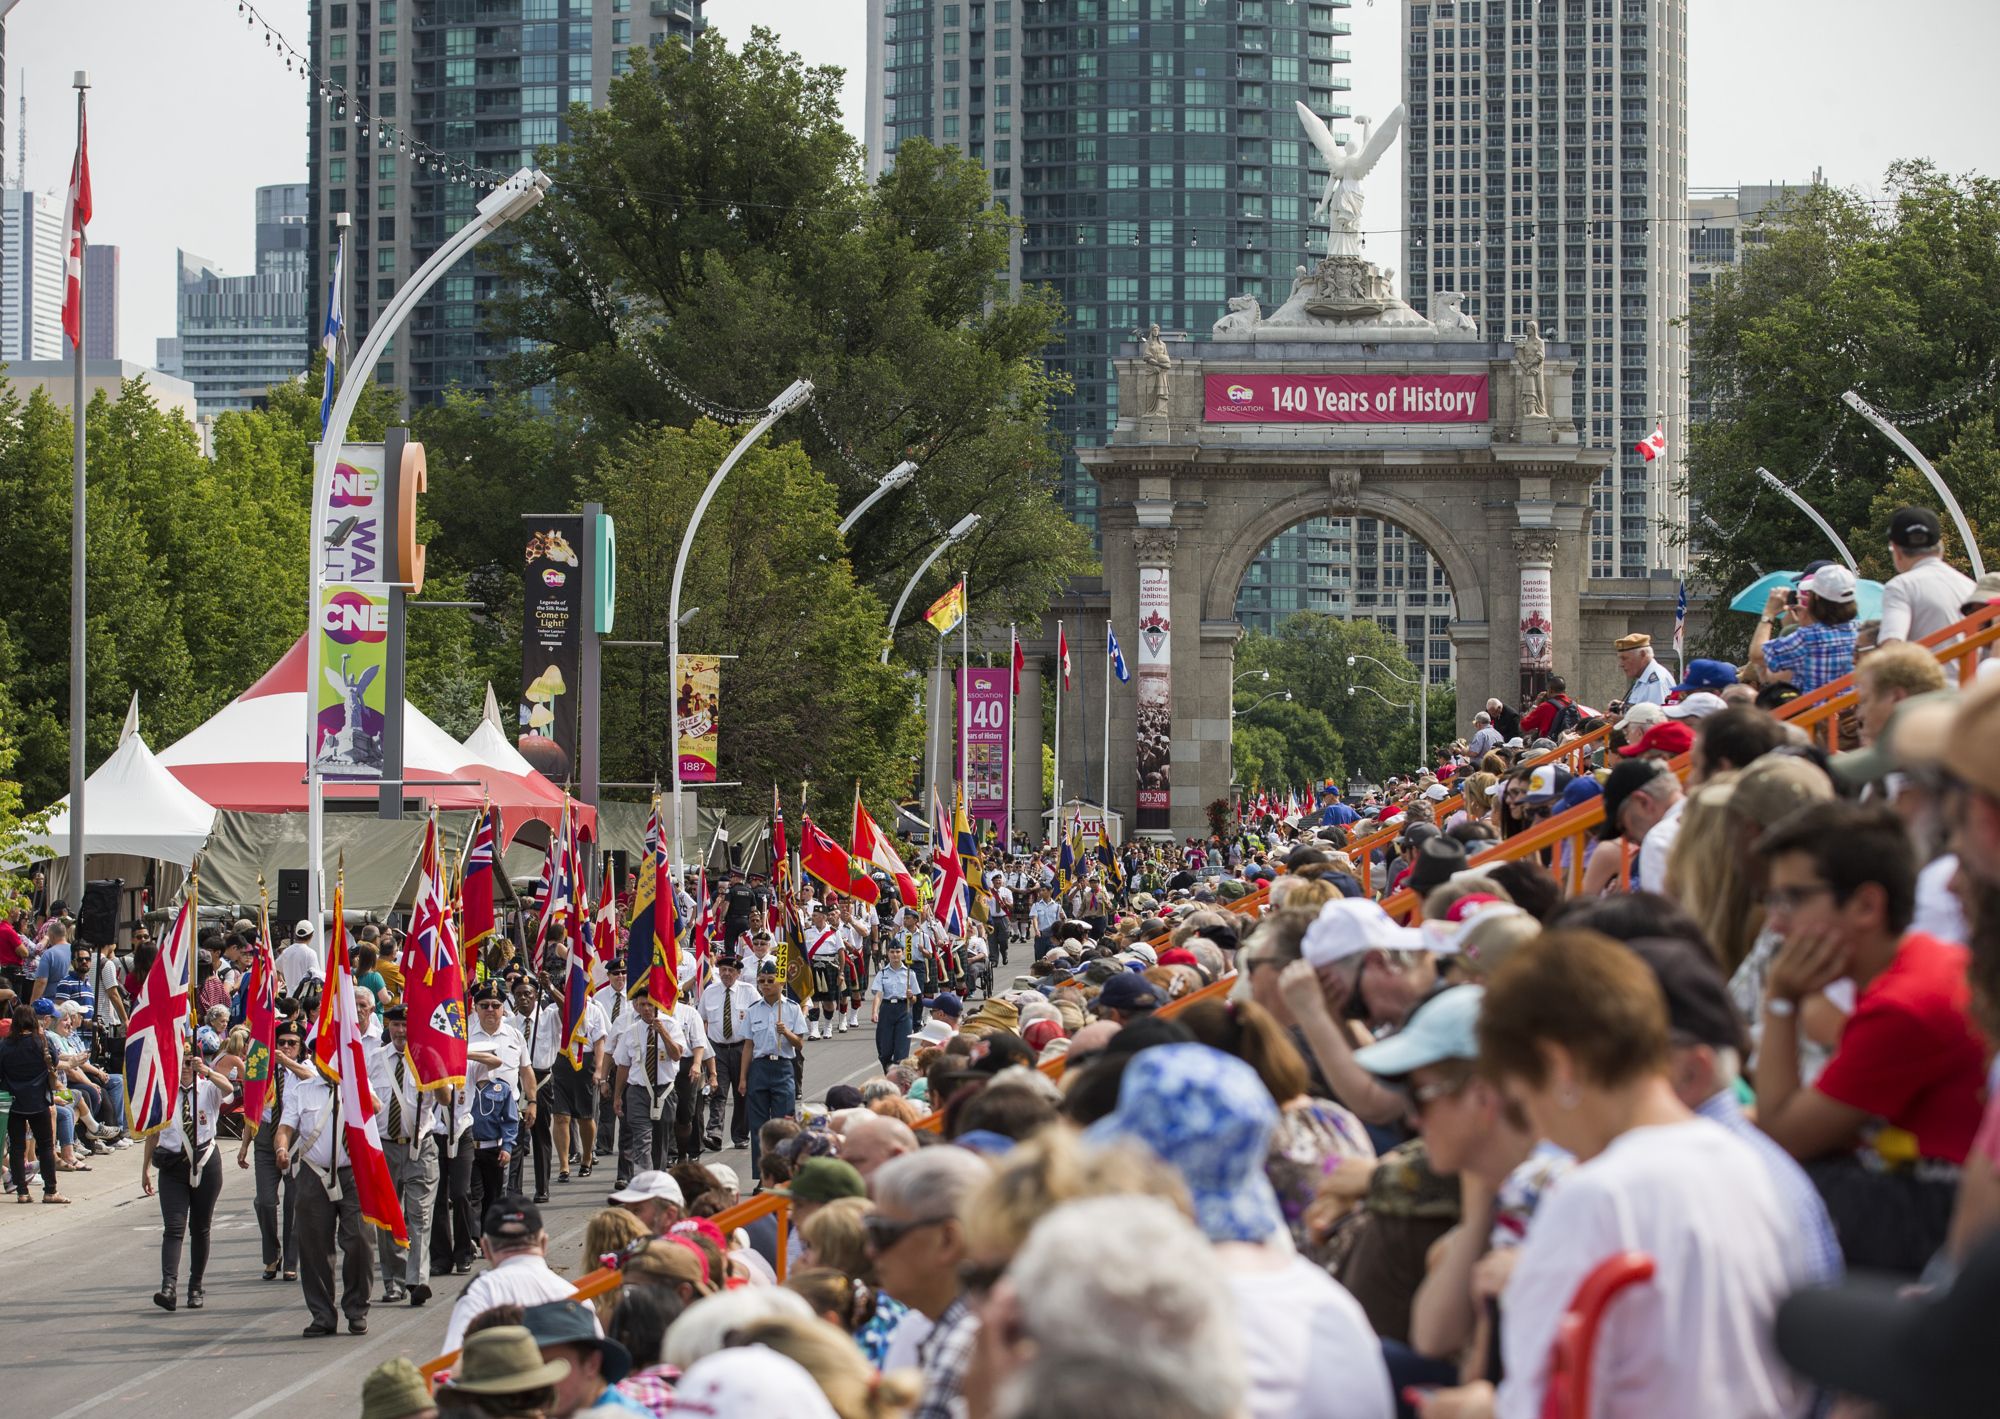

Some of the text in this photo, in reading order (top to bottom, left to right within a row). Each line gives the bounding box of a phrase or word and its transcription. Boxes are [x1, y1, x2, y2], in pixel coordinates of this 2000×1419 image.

[1230, 389, 1253, 400] CNE
[1271, 386, 1477, 416] 140 Years of History
[331, 473, 377, 497] NE
[321, 603, 389, 632] CNE
[536, 611, 559, 619] Come
[541, 619, 565, 629] Light!
[967, 701, 1003, 728] 140
[691, 722, 708, 736] LIST
[978, 732, 984, 740] of
[984, 732, 1002, 741] History
[683, 762, 706, 771] 1887
[1140, 793, 1167, 802] 1879-2018
